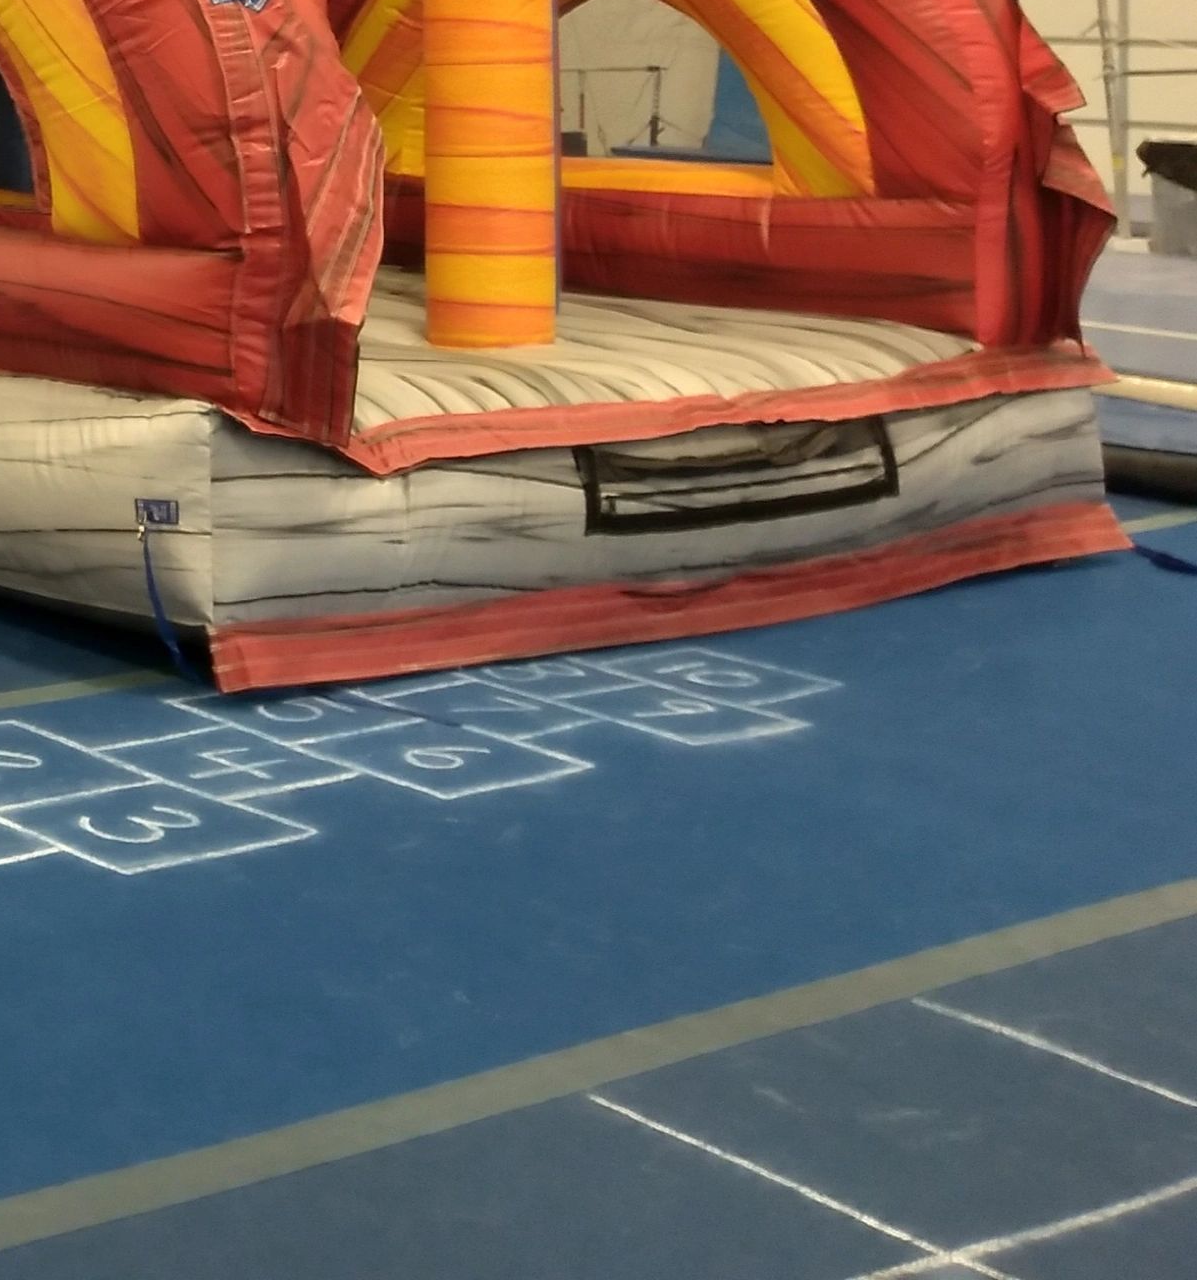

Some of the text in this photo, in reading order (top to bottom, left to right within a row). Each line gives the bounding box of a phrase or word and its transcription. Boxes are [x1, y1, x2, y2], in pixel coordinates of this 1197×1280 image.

[655, 662, 761, 688] 10
[256, 695, 356, 722] 5
[449, 695, 541, 713] 7
[634, 699, 718, 718] 9
[189, 747, 288, 780] 4
[404, 745, 491, 770] 6
[78, 805, 200, 843] 3
